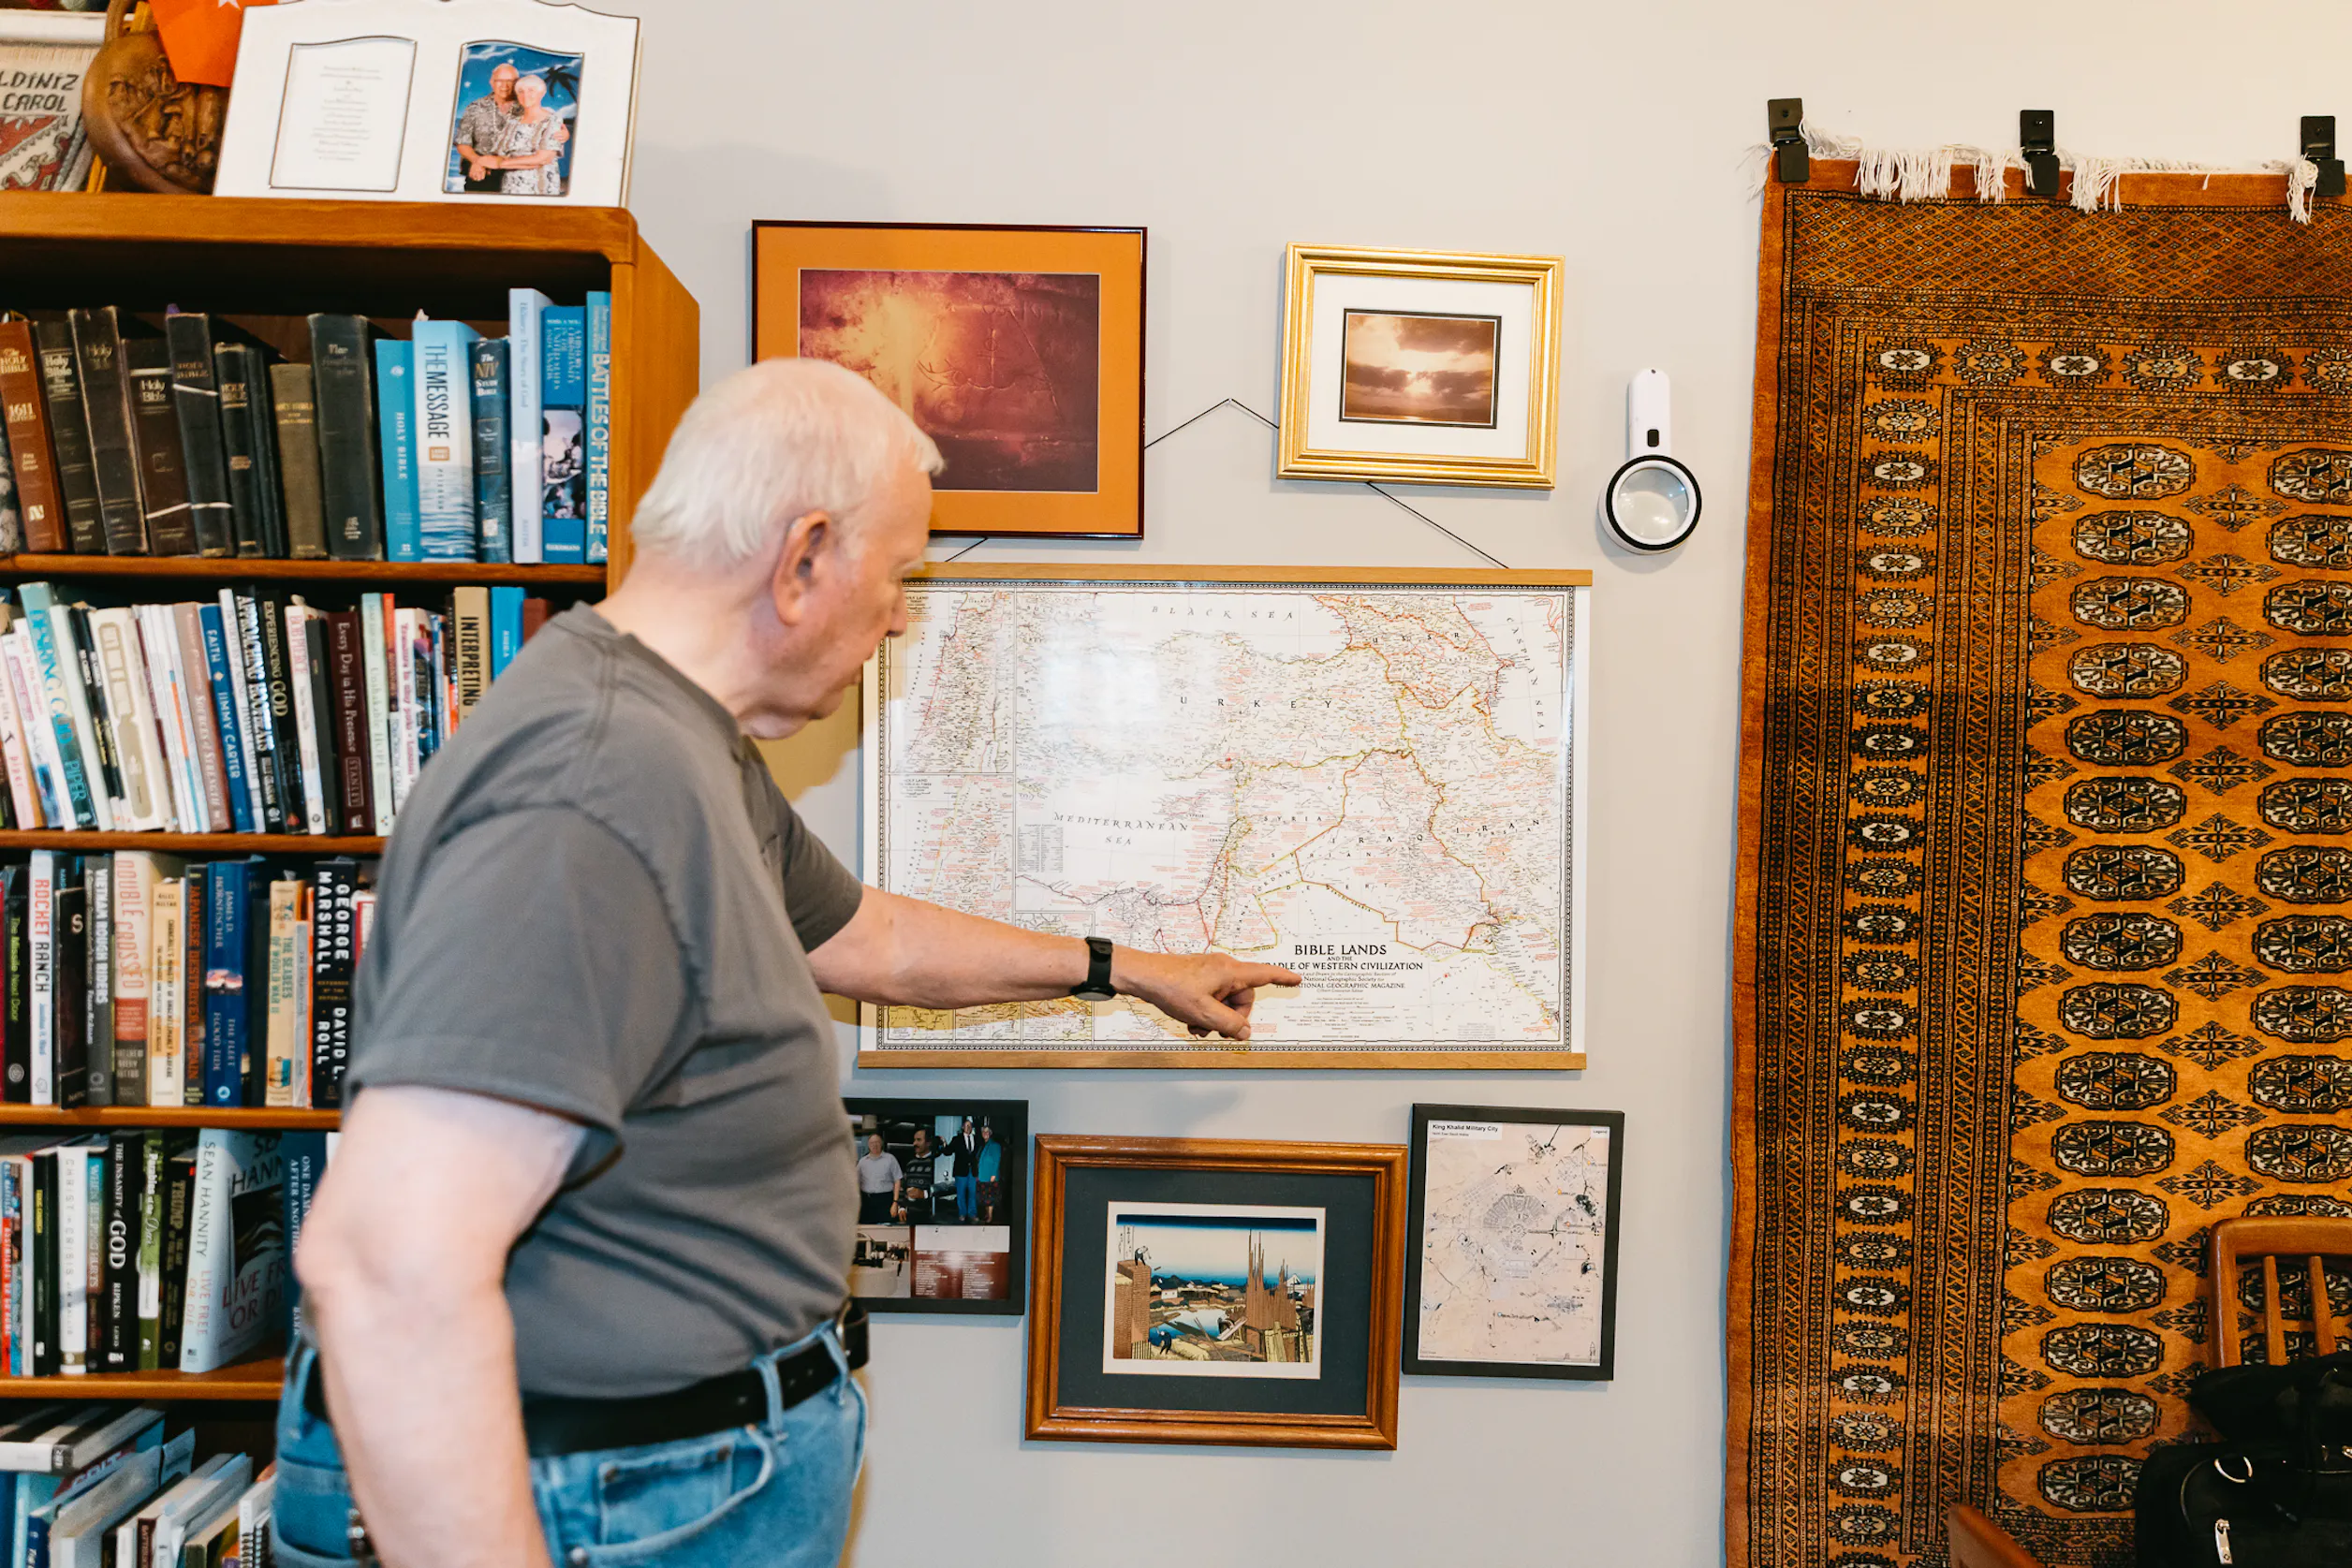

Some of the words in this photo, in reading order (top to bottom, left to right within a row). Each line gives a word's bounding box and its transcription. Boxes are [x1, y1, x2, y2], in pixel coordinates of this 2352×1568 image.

[3, 92, 67, 112] CAROL
[45, 355, 70, 369] Holy
[45, 364, 73, 377] Bible
[475, 363, 498, 378] NIV
[140, 379, 167, 392] Holy
[140, 390, 168, 403] Bible
[220, 384, 246, 393] HOLY
[592, 353, 610, 424] BATTLES
[8, 403, 34, 417] 1611
[395, 412, 407, 440] HOLY
[591, 426, 609, 448] OF
[398, 447, 408, 480] BIBLE
[591, 453, 609, 487] THE
[590, 490, 608, 535] BIBLE
[288, 615, 305, 637] BOB
[1152, 606, 1233, 620] BLACK
[1251, 610, 1294, 620] SEA
[206, 629, 221, 664] FAITH
[236, 594, 265, 681] APPROACHING
[263, 600, 283, 680] EXPERIENCING
[337, 622, 353, 651] Every
[290, 637, 309, 675] PIERCE
[339, 652, 356, 675] Day
[460, 616, 482, 707] INTERPRETING
[270, 681, 288, 717] GOD
[343, 677, 355, 687] in
[343, 689, 357, 708] His
[217, 692, 234, 731] JIMMY
[247, 682, 275, 753] HOOFBEATS
[344, 710, 359, 754] Presence
[224, 733, 242, 780] CARTER
[64, 759, 88, 803] PIPER
[347, 759, 361, 803] STANLEY
[1053, 812, 1189, 832] MEDITERRANEAN
[1105, 836, 1133, 845] SEA
[96, 868, 109, 919] VIETNAM
[115, 859, 146, 918] DOUBLE
[226, 891, 234, 921] JAMES
[10, 916, 21, 934] The
[35, 879, 51, 936] ROCKET
[188, 886, 201, 947] JAPANESE
[214, 876, 225, 948] HORNFISCHER
[316, 871, 332, 974] MARSHALL
[334, 883, 350, 960] GEORGE
[10, 935, 21, 973] Missile
[95, 921, 109, 961] ROUGH
[114, 921, 146, 989] CROSSED
[282, 936, 293, 954] THE
[1294, 945, 1335, 956] BIBLE
[1340, 945, 1388, 956] LANDS
[10, 974, 21, 996] Next
[35, 941, 51, 993] RANCH
[95, 963, 109, 1004] RIDERS
[282, 956, 293, 999] SEABEES
[188, 950, 200, 1023] DESTROYER
[10, 998, 21, 1022] Door
[316, 1020, 331, 1065] ROLL
[333, 1007, 347, 1060] DAVID
[188, 1026, 199, 1080] CAPTAIN
[332, 1065, 346, 1081] L.
[115, 1143, 124, 1162] THE
[201, 1140, 216, 1181] SEAN
[301, 1155, 312, 1180] ONE
[65, 1159, 75, 1211] CHRIST
[89, 1164, 99, 1201] WHEN
[114, 1163, 124, 1208] INSANITY
[147, 1153, 158, 1194] Parables
[290, 1159, 300, 1196] AFTER
[170, 1180, 186, 1230] TRUMP
[197, 1186, 213, 1257] HANNITY
[65, 1226, 75, 1276] CRISIS
[109, 1220, 127, 1269] GOD
[88, 1252, 99, 1288] HURTS
[187, 1278, 198, 1297] OR
[199, 1269, 213, 1299] LIVE
[112, 1282, 121, 1318] RIPKEN
[221, 1269, 260, 1310] LIVE
[186, 1303, 197, 1326] DIE
[197, 1305, 210, 1336] FREE
[230, 1299, 259, 1331] OR
